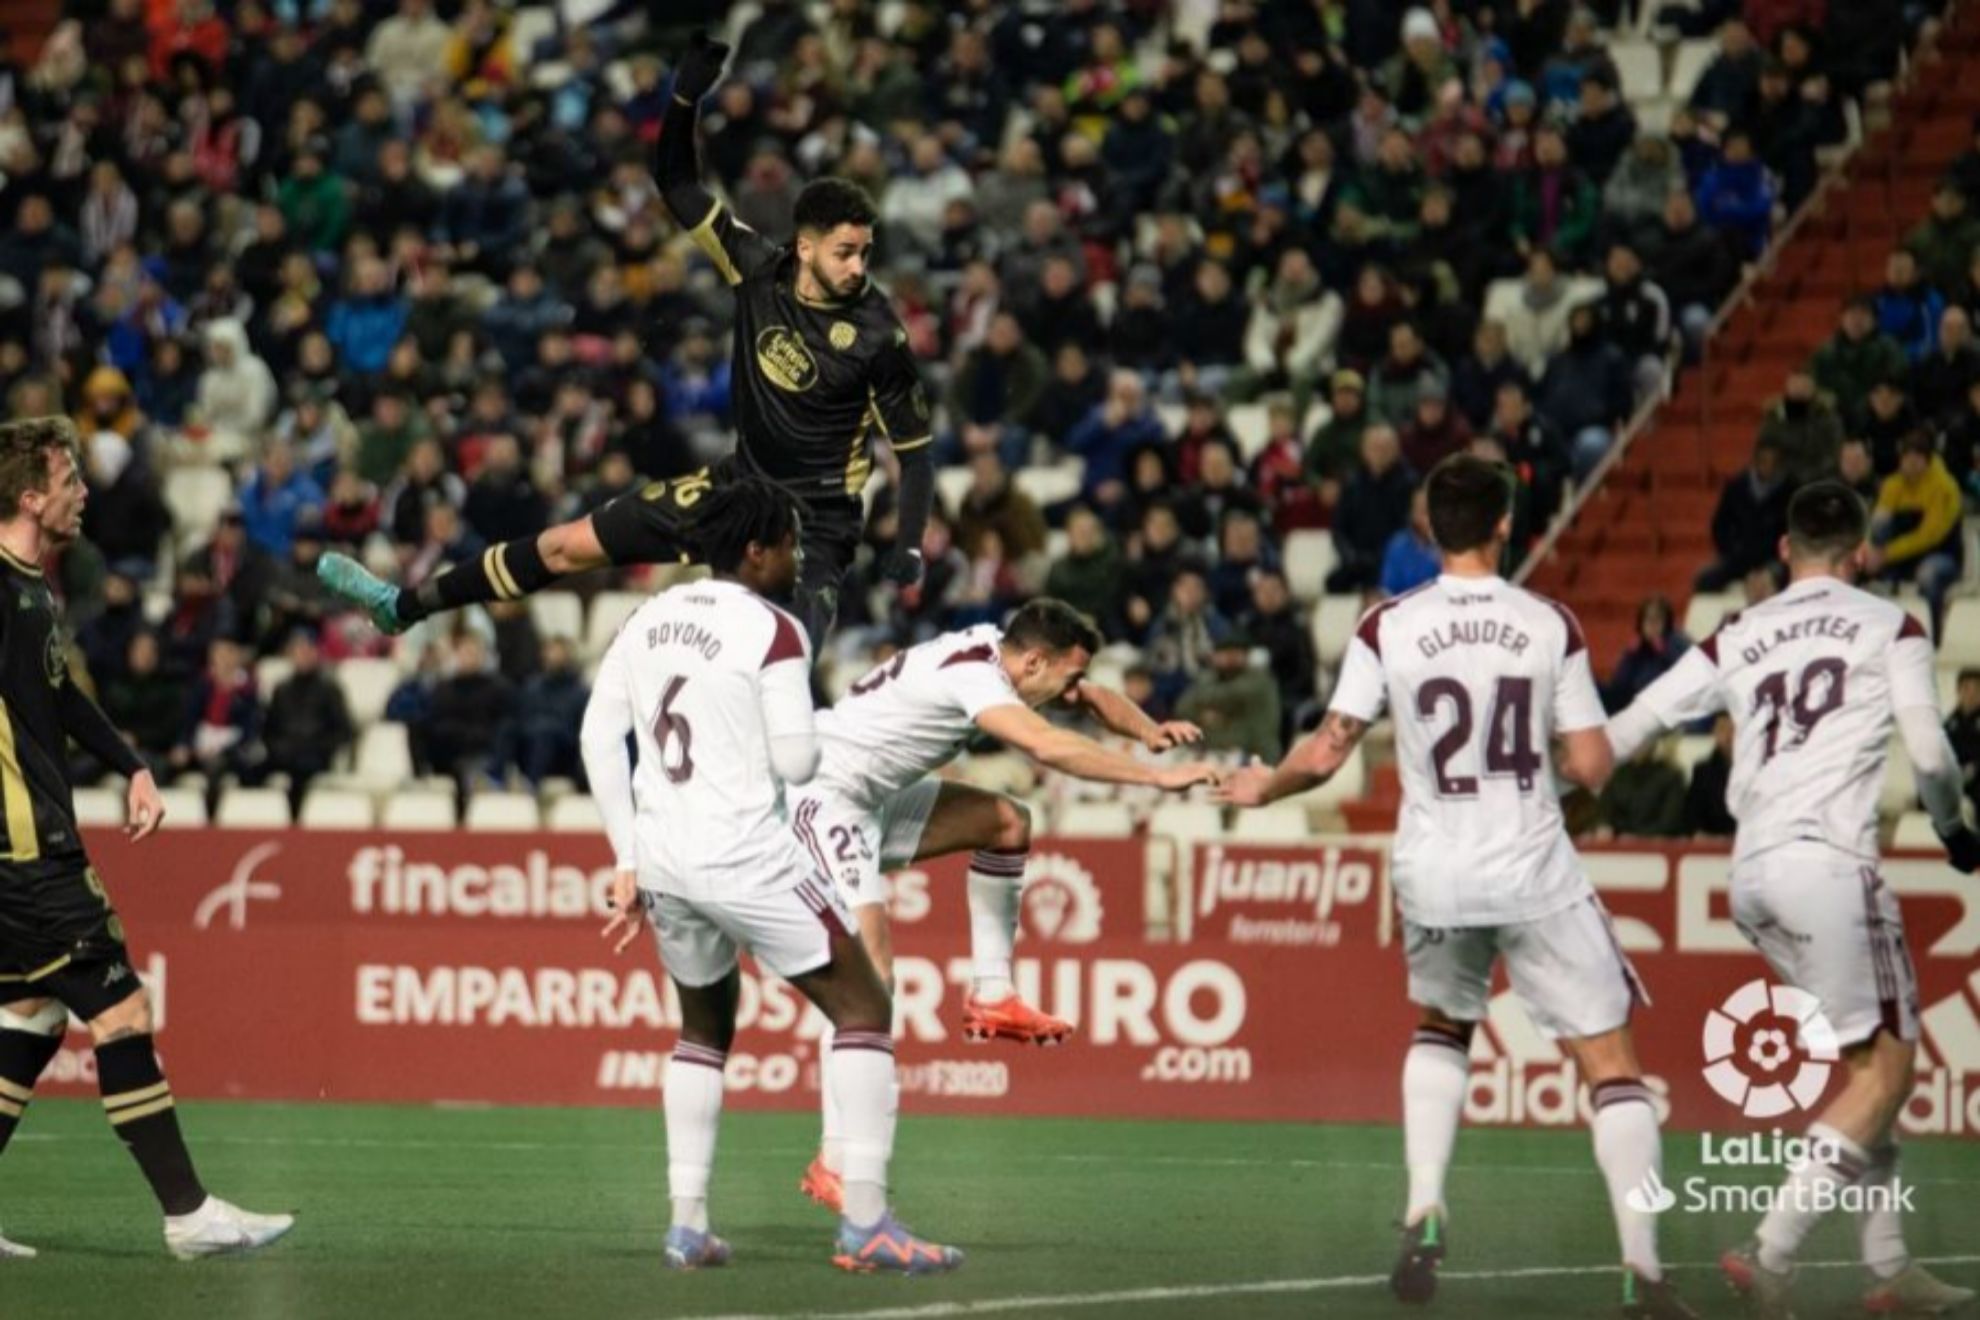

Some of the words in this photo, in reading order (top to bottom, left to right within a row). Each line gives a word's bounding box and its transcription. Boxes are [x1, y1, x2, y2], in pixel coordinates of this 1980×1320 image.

[647, 621, 723, 661] BOYOMO
[1417, 619, 1531, 660] GLAUDER
[654, 674, 694, 784] 6
[1414, 675, 1542, 798] 24
[1751, 656, 1847, 763] 19
[1200, 846, 1373, 919] juanjo
[1141, 1045, 1252, 1082] .com
